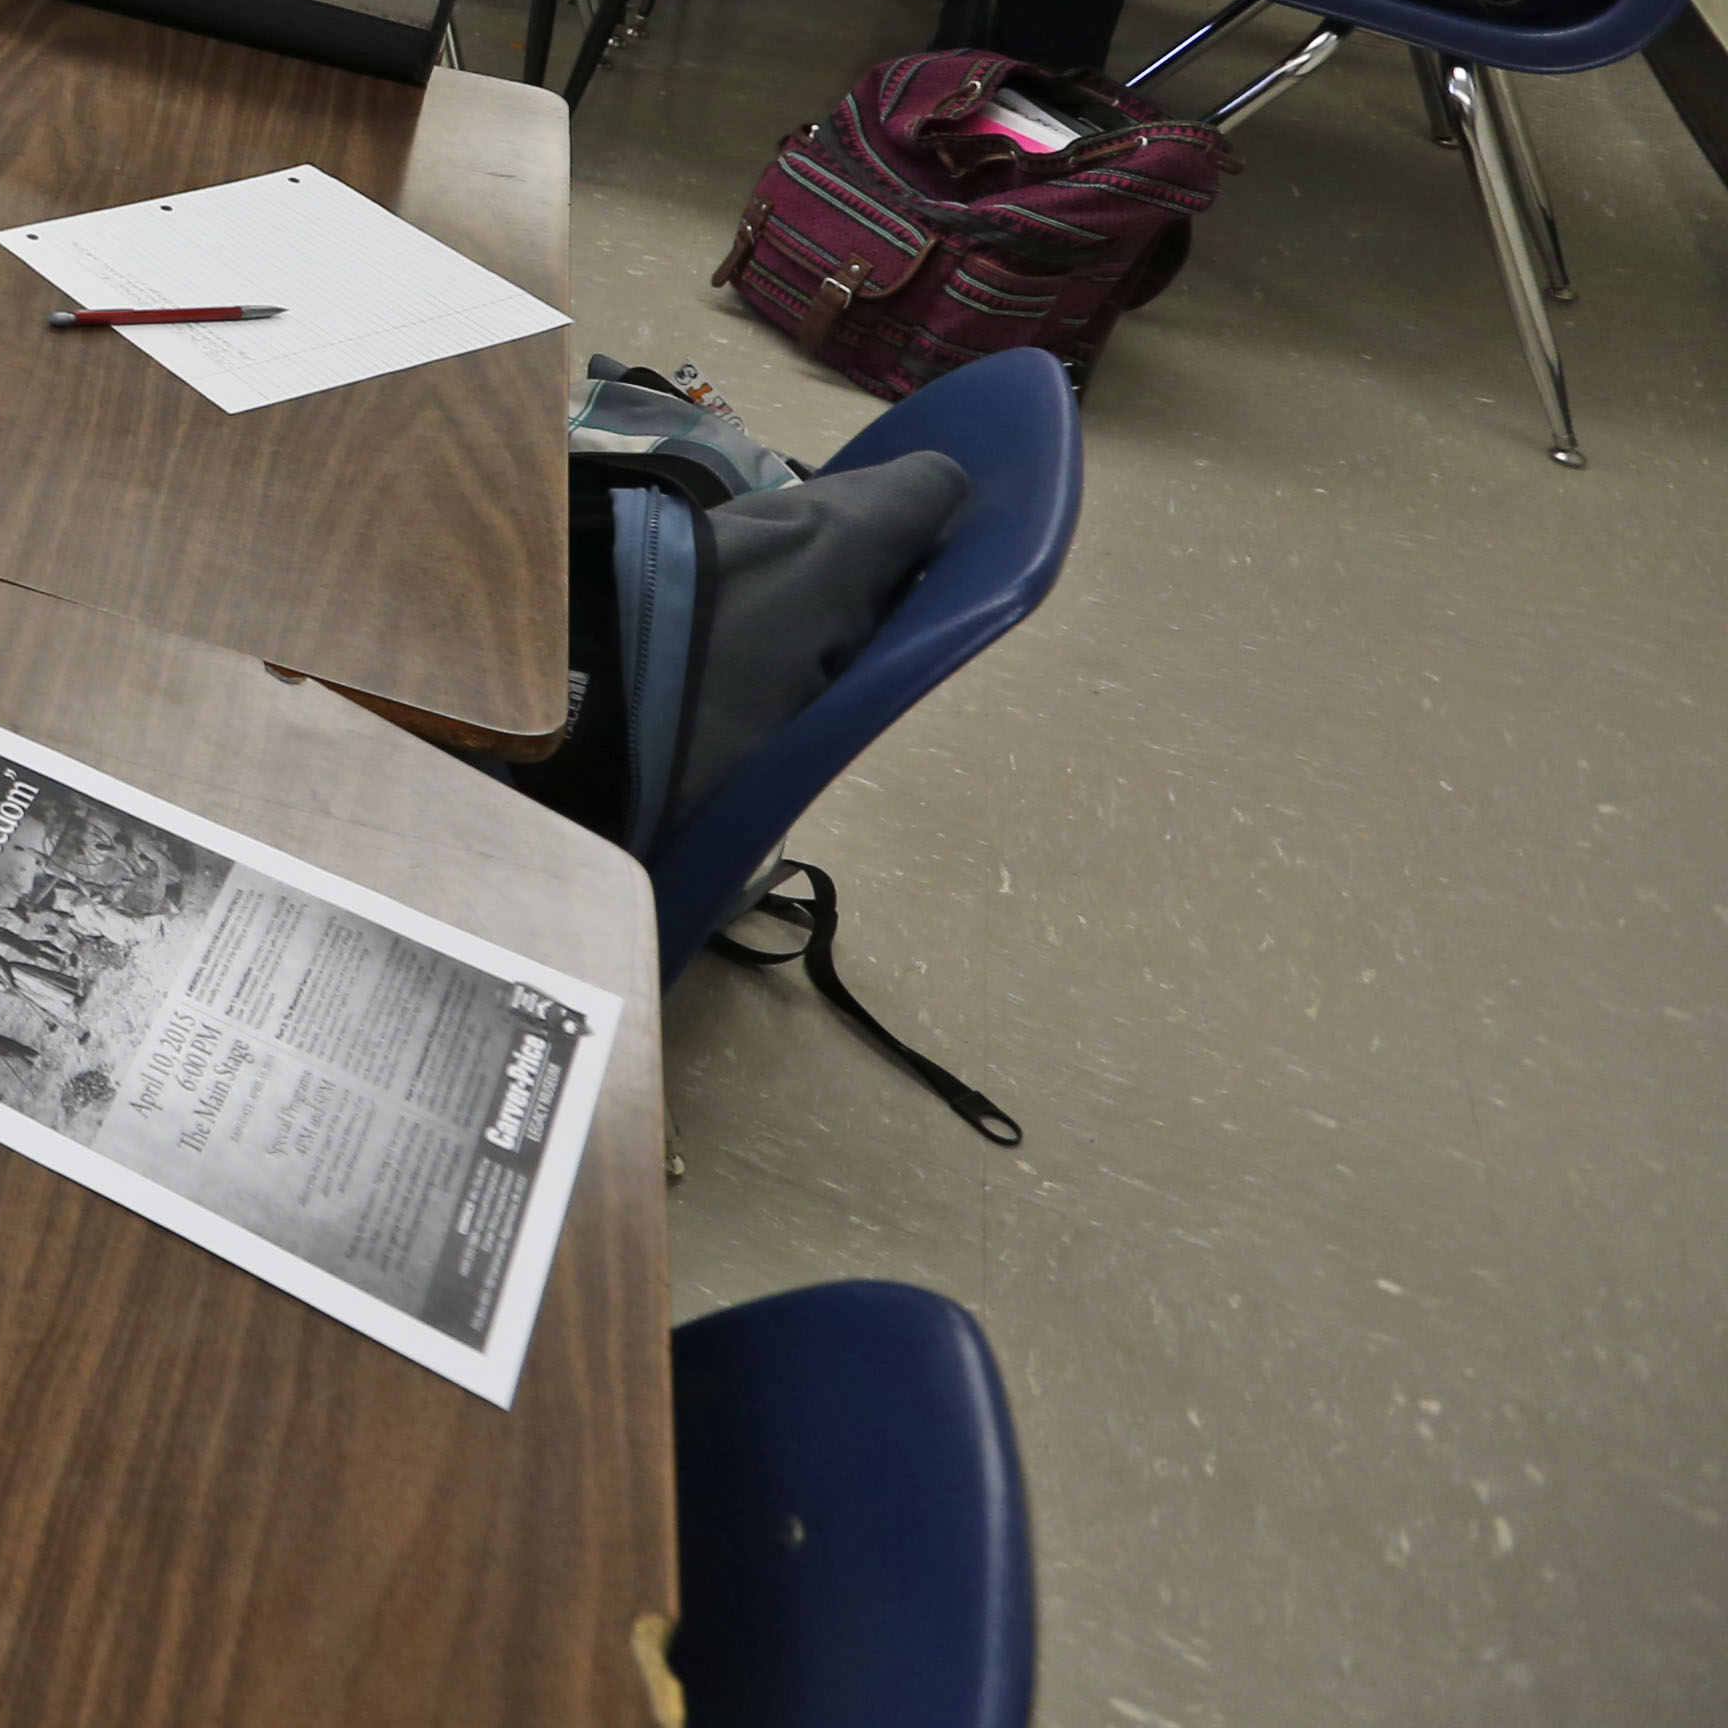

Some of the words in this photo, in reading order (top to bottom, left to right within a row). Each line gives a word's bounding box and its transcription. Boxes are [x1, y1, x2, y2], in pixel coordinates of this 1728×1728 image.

[159, 1011, 195, 1054] 2015
[191, 1023, 223, 1056] PM
[148, 1052, 180, 1077] 10,
[175, 1052, 209, 1092] 6:00
[212, 1039, 256, 1082] Stage
[129, 1071, 165, 1120] April
[193, 1079, 232, 1124] Main
[265, 1111, 294, 1155] Special
[281, 1069, 314, 1120] Programs
[177, 1123, 212, 1154] The
[525, 1101, 551, 1143] LEGACY
